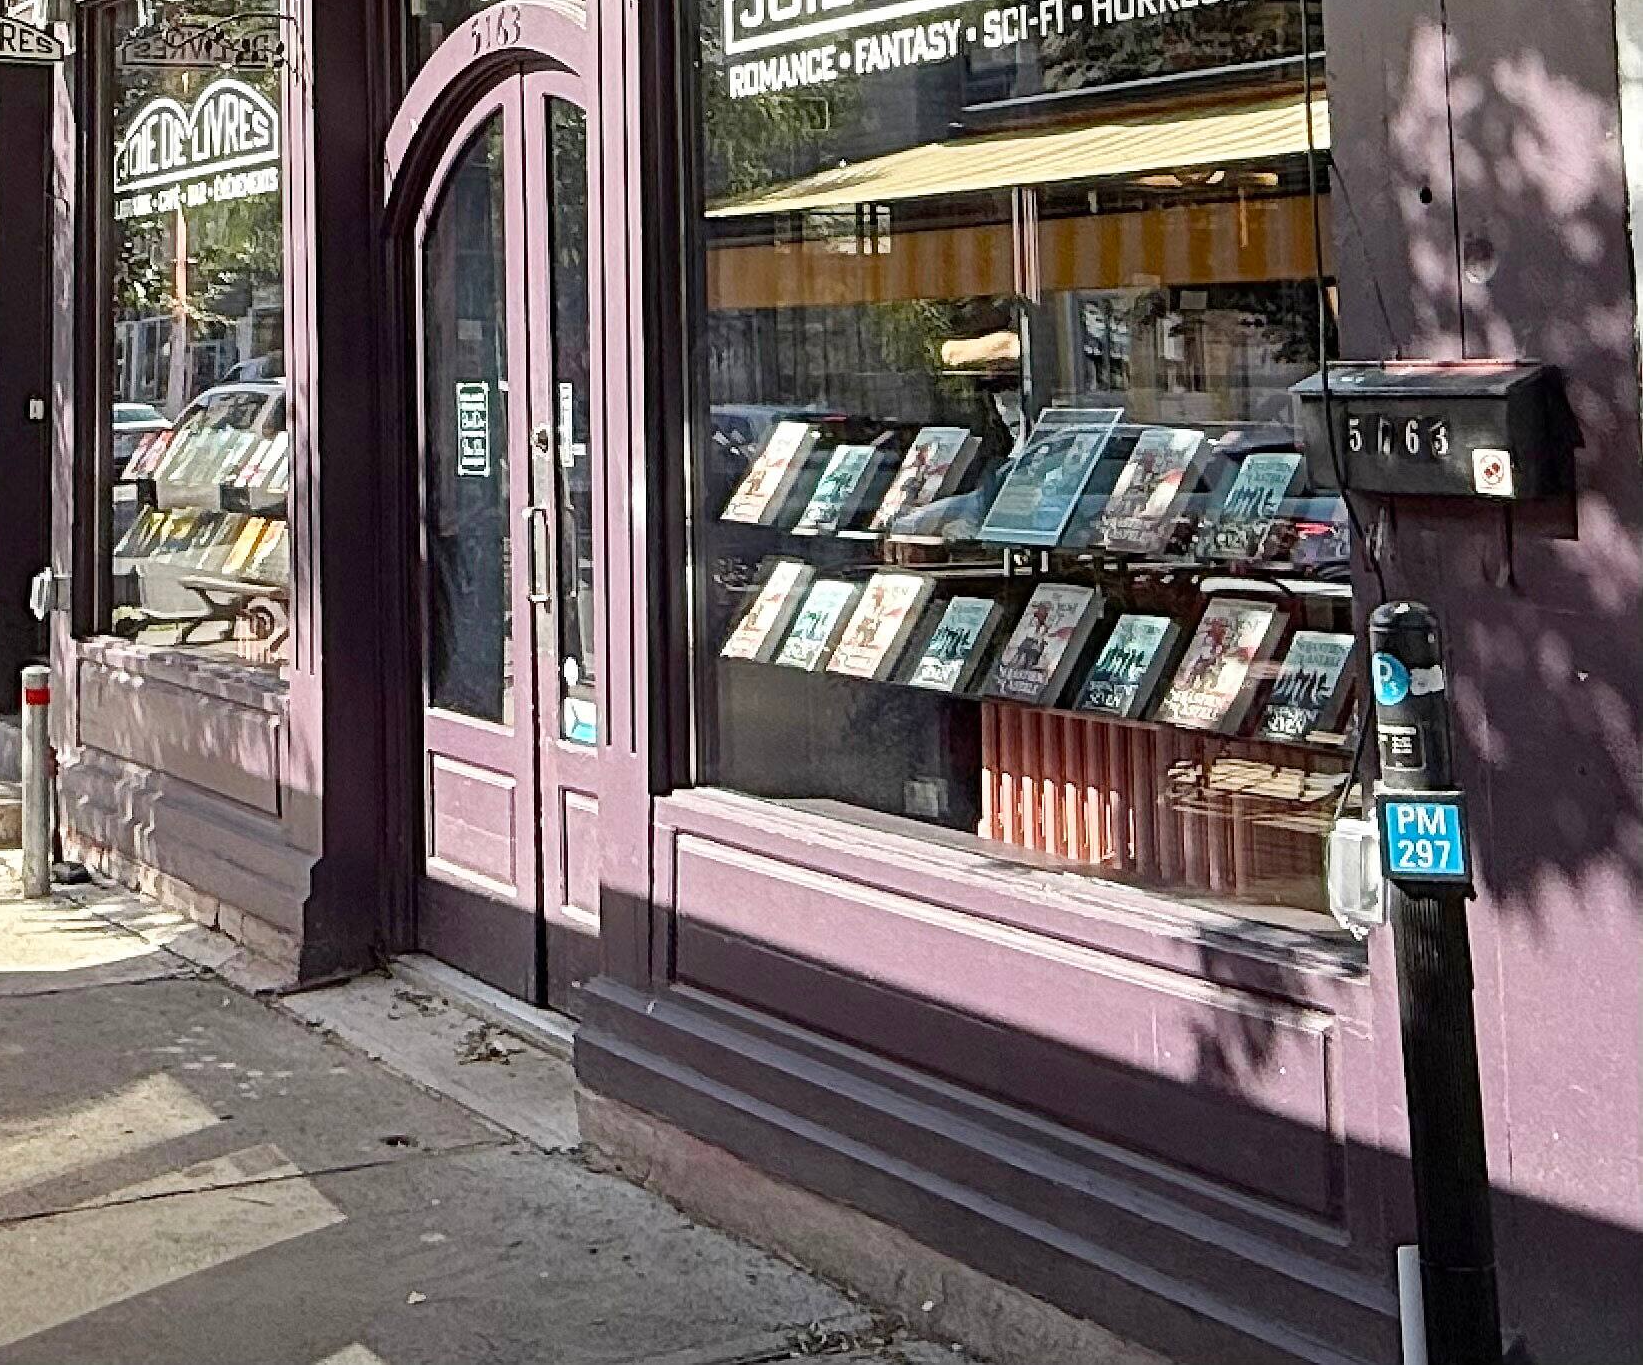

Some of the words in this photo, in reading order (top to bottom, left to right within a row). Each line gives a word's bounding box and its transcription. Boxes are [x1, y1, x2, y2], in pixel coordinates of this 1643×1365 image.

[471, 5, 522, 56] 5163
[728, 45, 837, 100] ROMANCE
[854, 21, 961, 75] FANTASY
[119, 113, 159, 179] JOIE
[161, 112, 187, 170] DE
[191, 92, 270, 163] LIVRES
[1397, 805, 1448, 836] PM
[1397, 838, 1451, 870] 297
